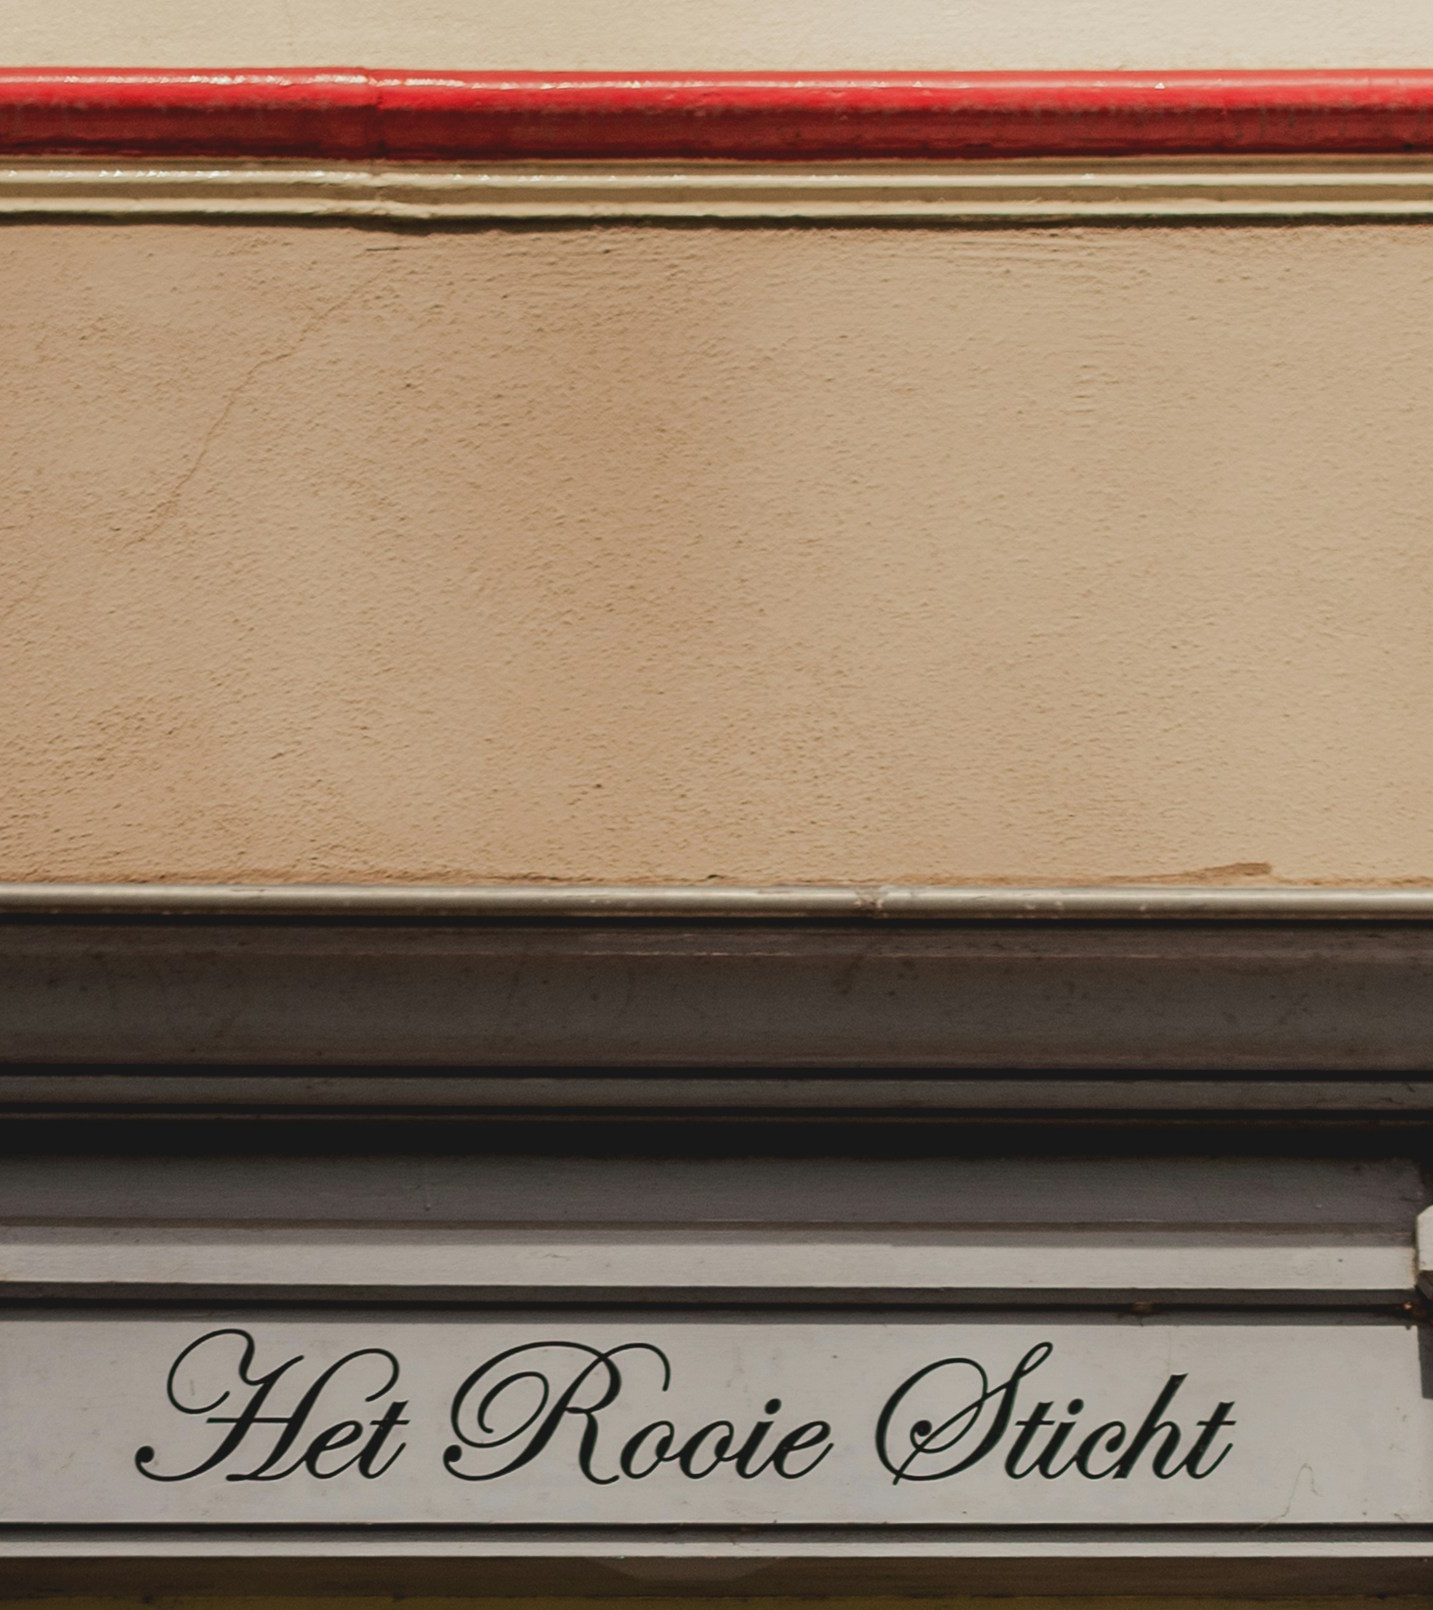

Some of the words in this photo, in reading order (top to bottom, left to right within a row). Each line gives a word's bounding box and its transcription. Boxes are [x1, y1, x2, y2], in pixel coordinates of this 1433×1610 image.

[133, 1327, 411, 1484] Het
[441, 1339, 835, 1487] Rooie
[873, 1340, 1238, 1487] Sticht
